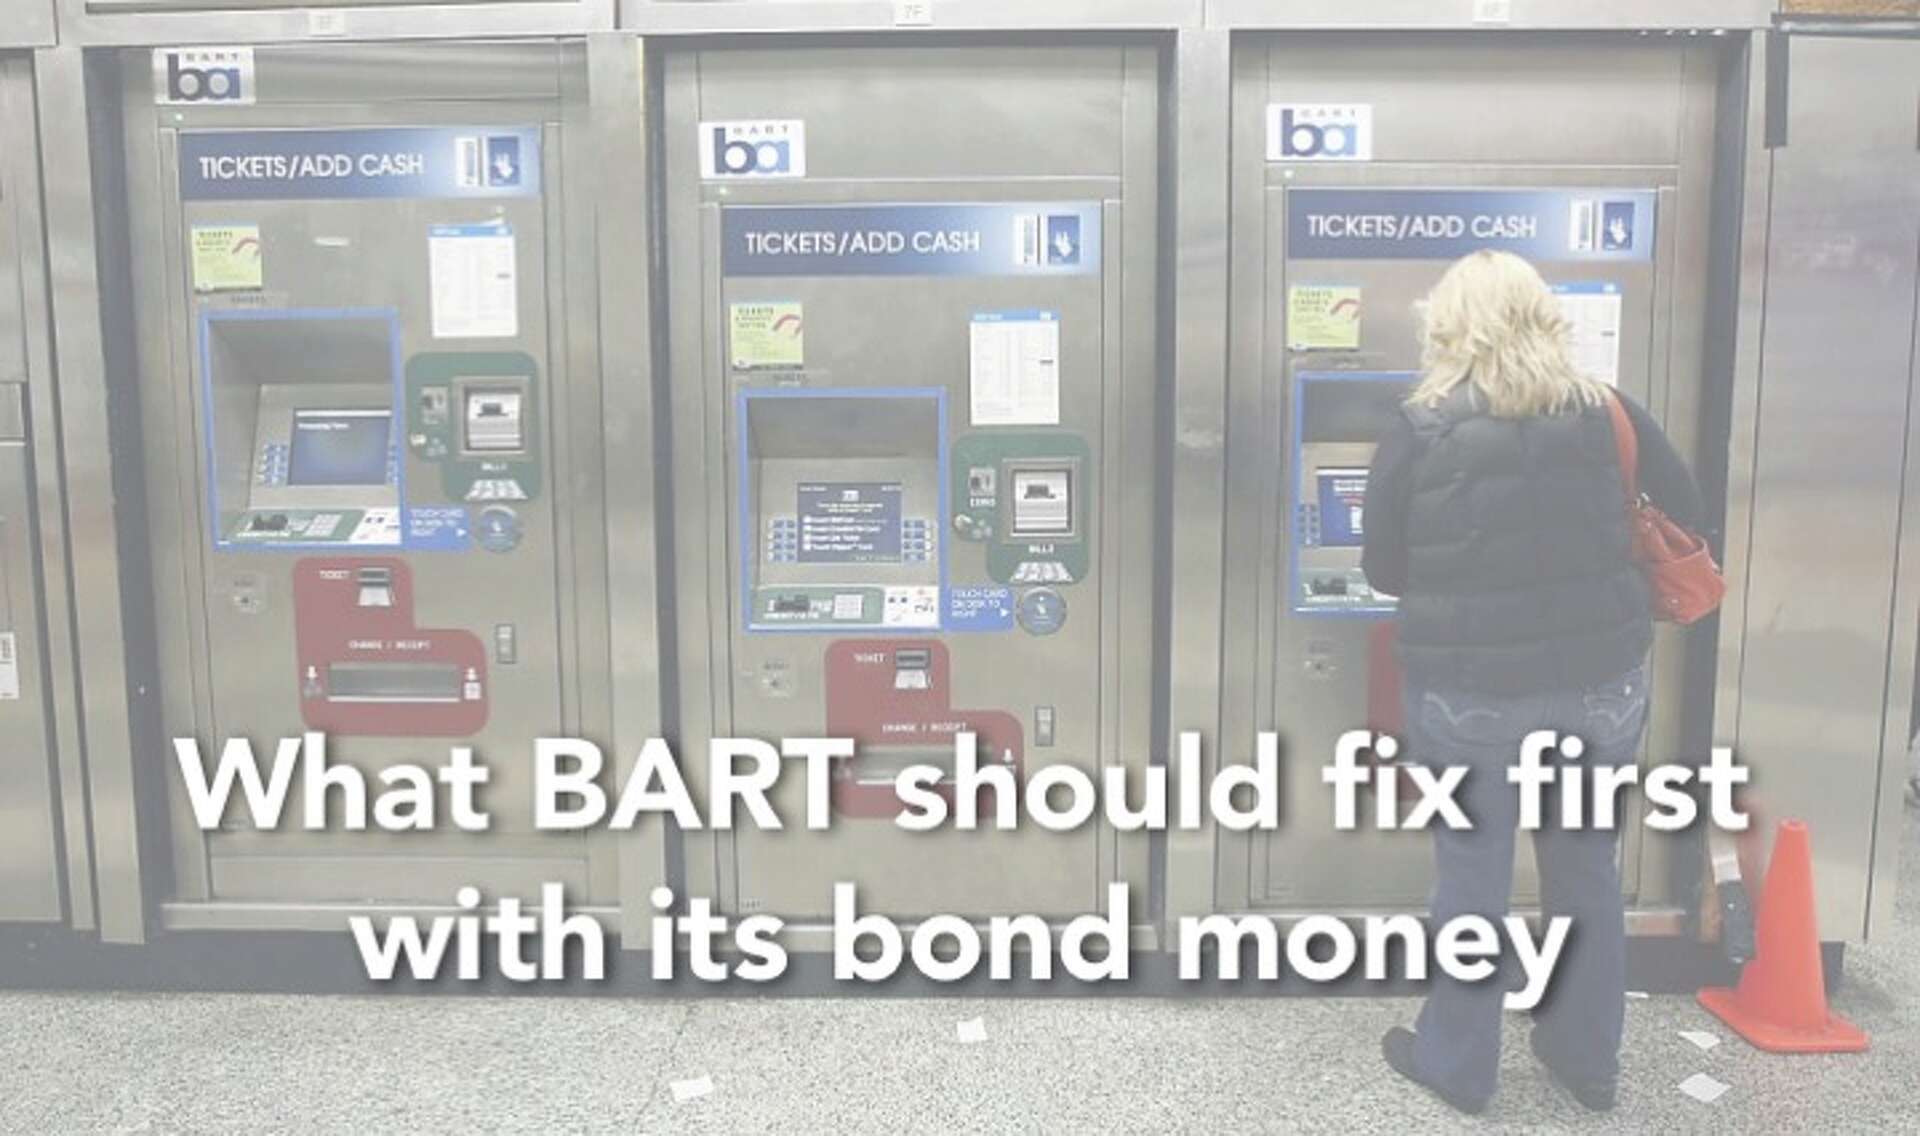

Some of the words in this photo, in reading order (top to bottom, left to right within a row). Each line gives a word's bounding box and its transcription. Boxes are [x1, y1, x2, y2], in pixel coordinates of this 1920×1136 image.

[199, 154, 350, 180] TICKETS/ADD
[359, 153, 423, 177] CASH
[1306, 215, 1465, 241] TICKETS/ADD
[1471, 215, 1537, 239] CASH
[745, 231, 905, 256] TICKETS/ADD
[912, 231, 980, 253] CASH
